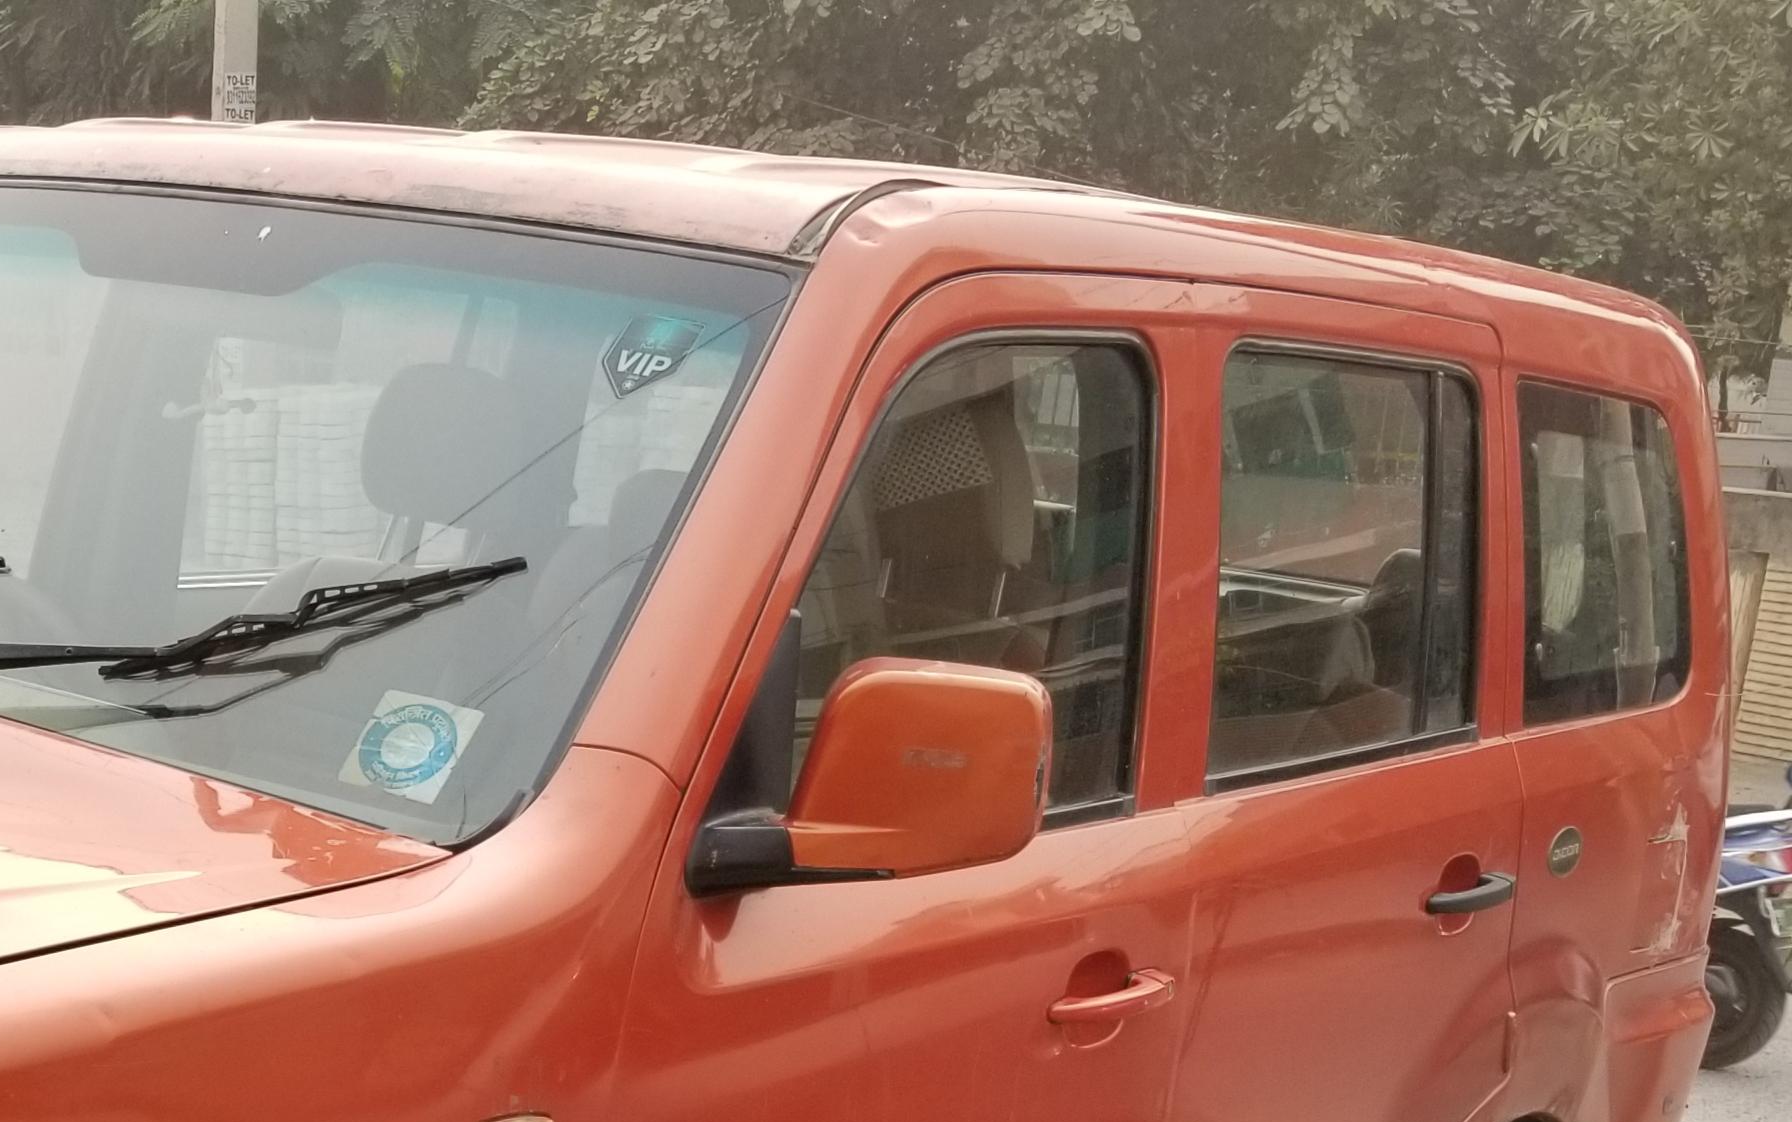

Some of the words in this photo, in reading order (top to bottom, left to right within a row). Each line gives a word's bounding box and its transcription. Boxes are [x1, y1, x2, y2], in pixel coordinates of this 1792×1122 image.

[226, 75, 255, 86] TO-LET
[225, 108, 254, 120] TO-LET
[616, 349, 672, 377] VIP
